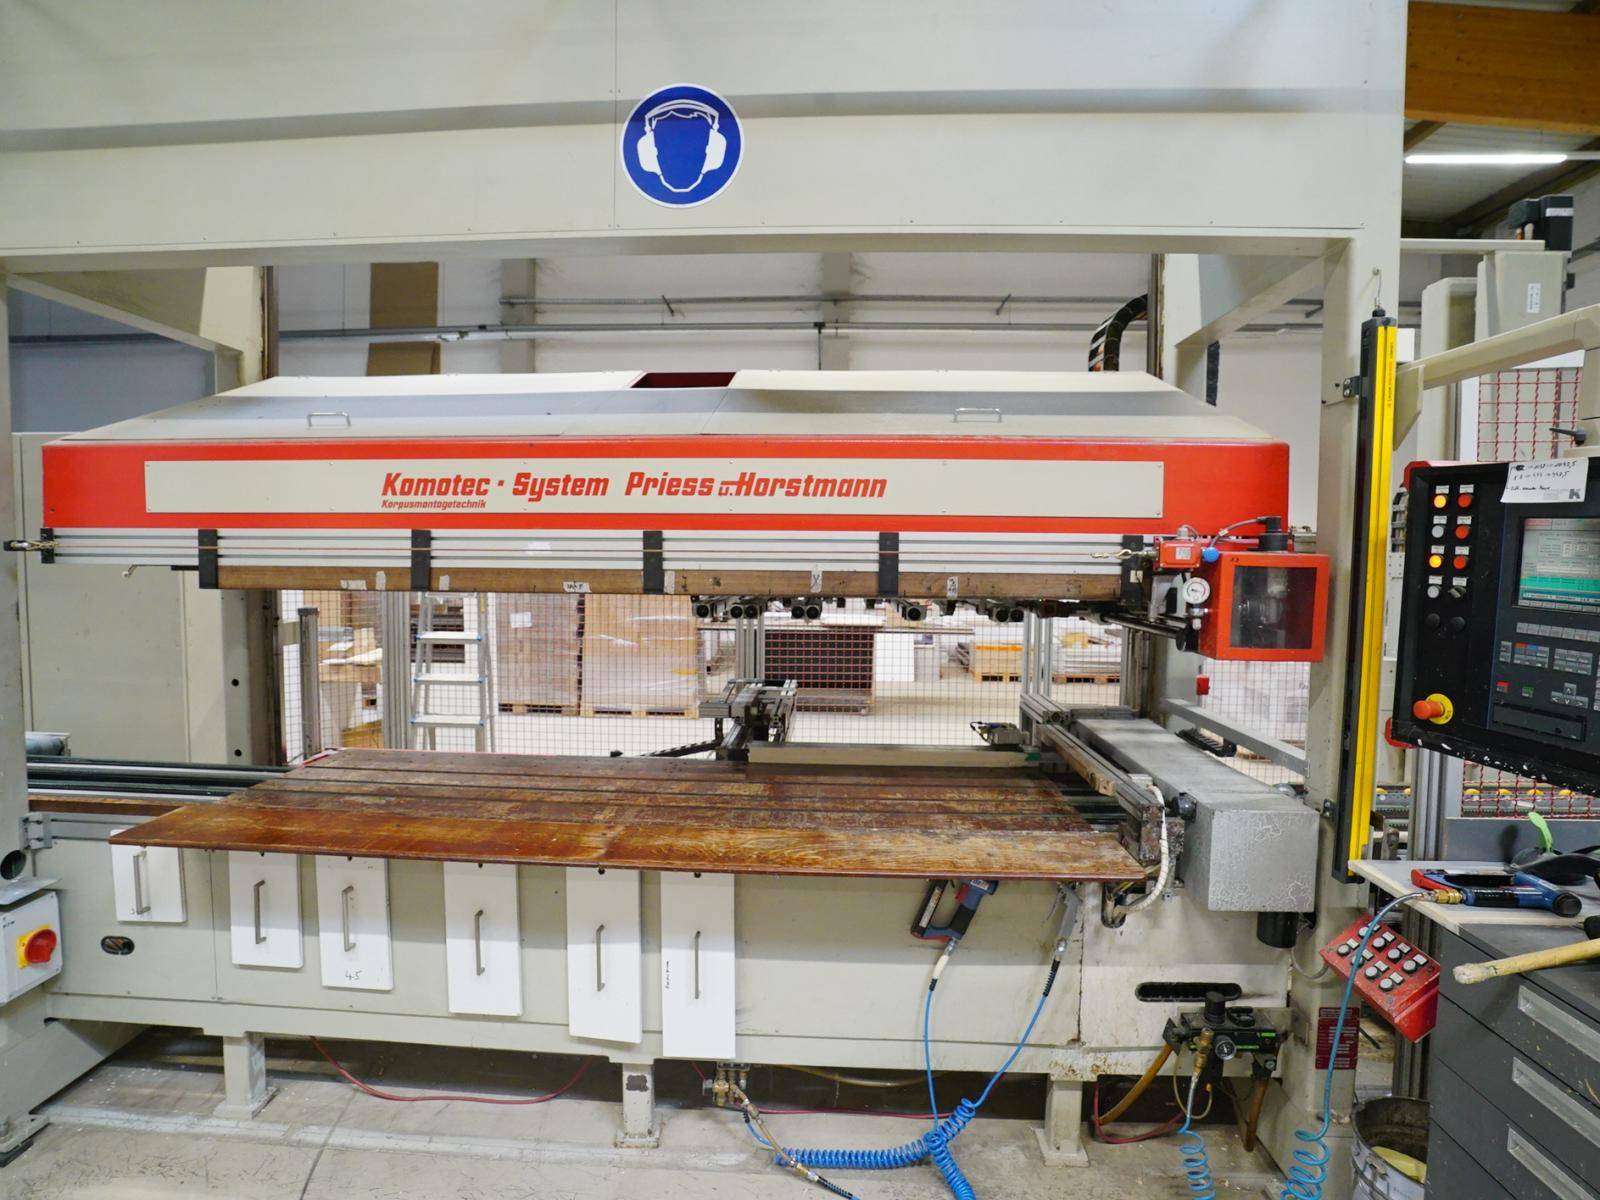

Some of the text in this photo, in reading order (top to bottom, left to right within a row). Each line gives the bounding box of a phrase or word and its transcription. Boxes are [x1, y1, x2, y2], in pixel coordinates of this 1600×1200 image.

[511, 471, 610, 503] System
[624, 471, 716, 496] Priess
[730, 471, 889, 498] Horstmann
[381, 499, 487, 511] Korpusmontagetechnik
